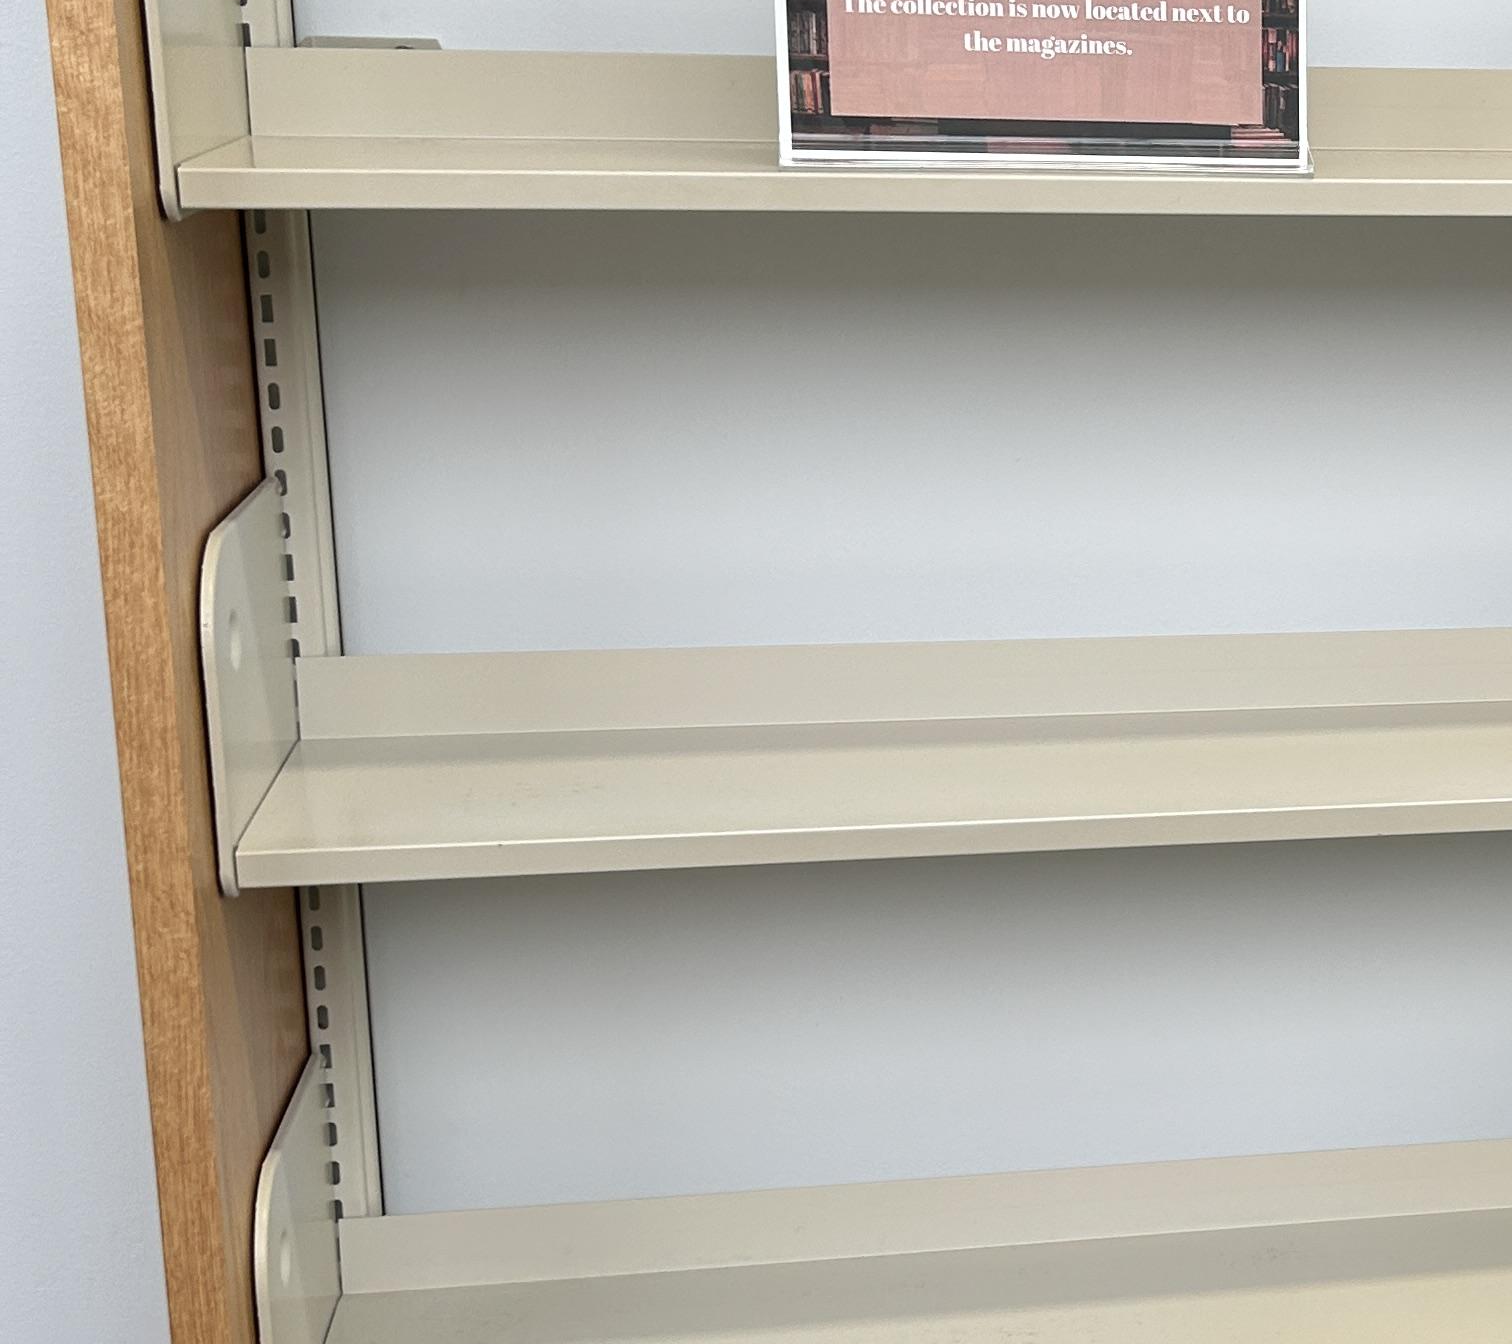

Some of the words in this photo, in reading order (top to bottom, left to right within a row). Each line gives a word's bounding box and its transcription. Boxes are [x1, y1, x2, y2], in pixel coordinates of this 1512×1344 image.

[1031, 3, 1080, 19] now
[1172, 4, 1223, 23] next
[1227, 4, 1250, 24] to
[964, 30, 1002, 52] the
[1006, 33, 1133, 60] magazines.
